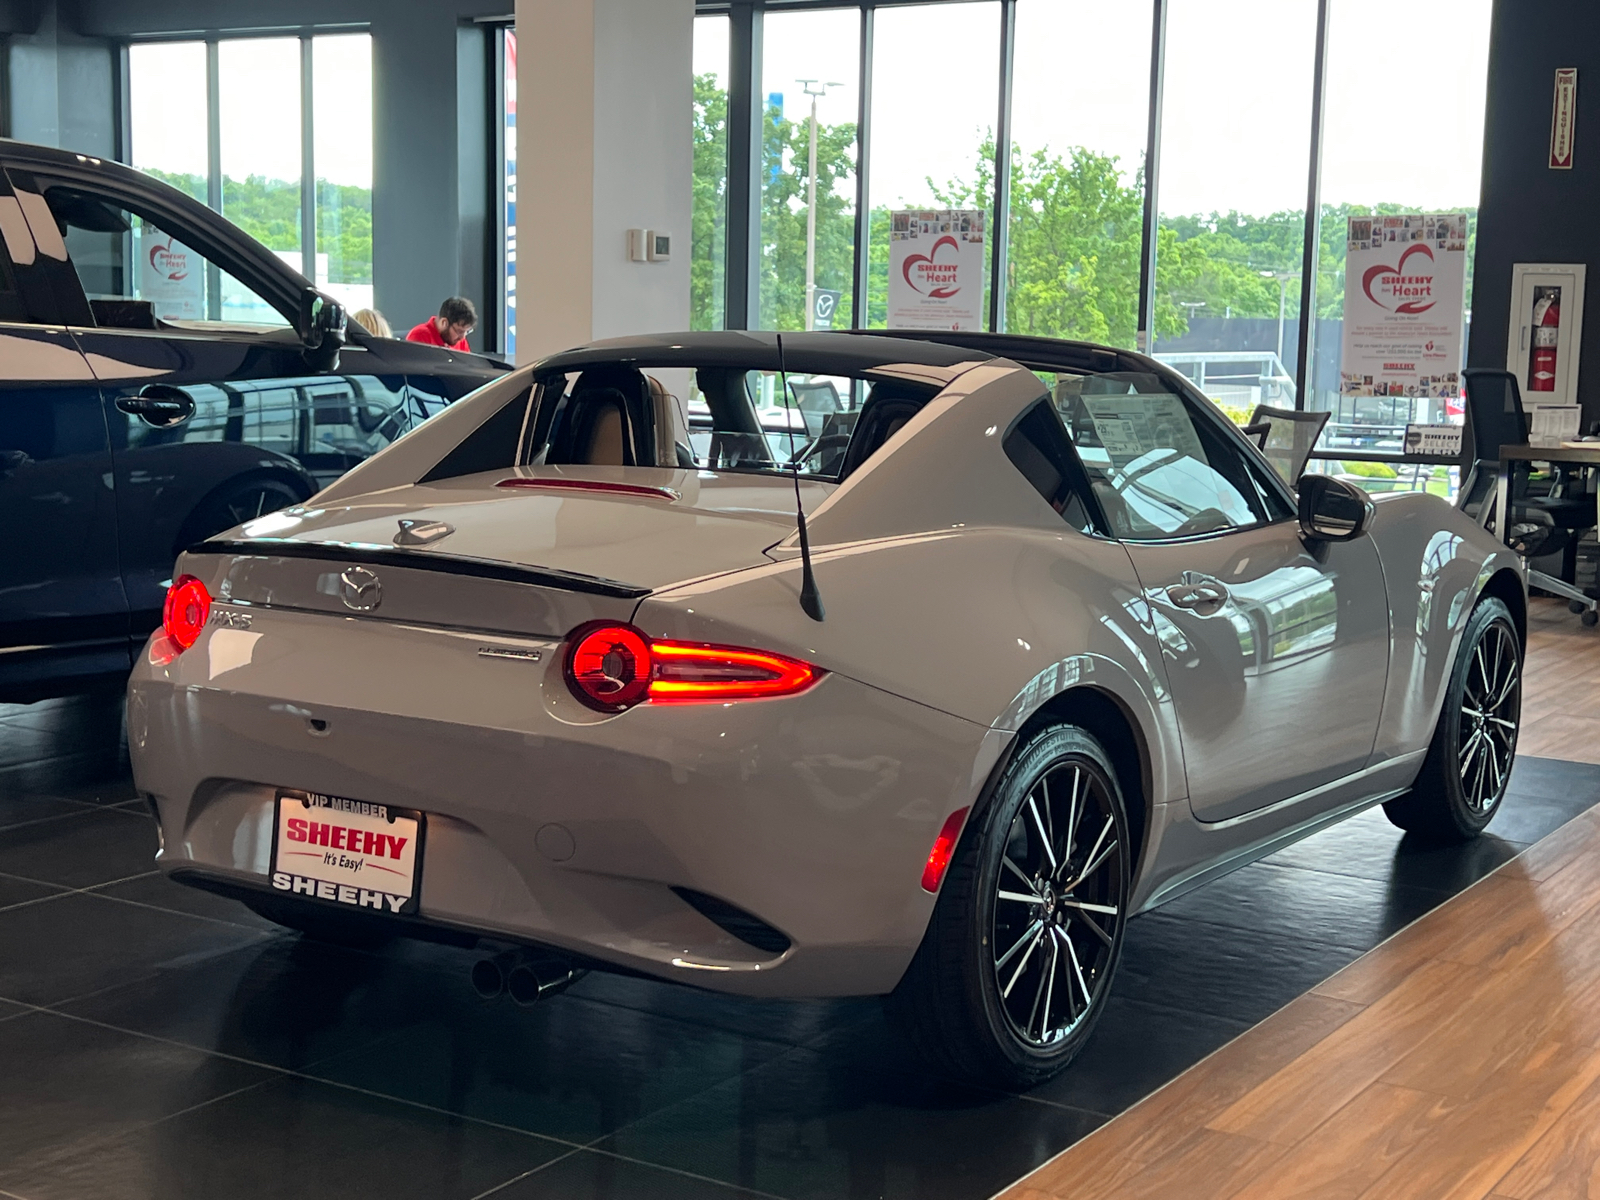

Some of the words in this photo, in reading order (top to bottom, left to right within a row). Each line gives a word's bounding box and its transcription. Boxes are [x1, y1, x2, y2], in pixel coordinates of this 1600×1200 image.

[1559, 76, 1573, 85] FIRE
[1558, 87, 1569, 157] EXTINGUISHER
[926, 272, 957, 282] Heart
[1381, 276, 1433, 284] SHEEHY
[1393, 285, 1431, 296] Heart
[210, 610, 252, 629] MX-5
[306, 793, 328, 809] VIP
[331, 797, 388, 819] MEMBER
[287, 818, 408, 860] SHEEHY
[323, 852, 337, 866] It's
[339, 855, 363, 873] Easy!
[272, 873, 409, 914] SHEEHY
